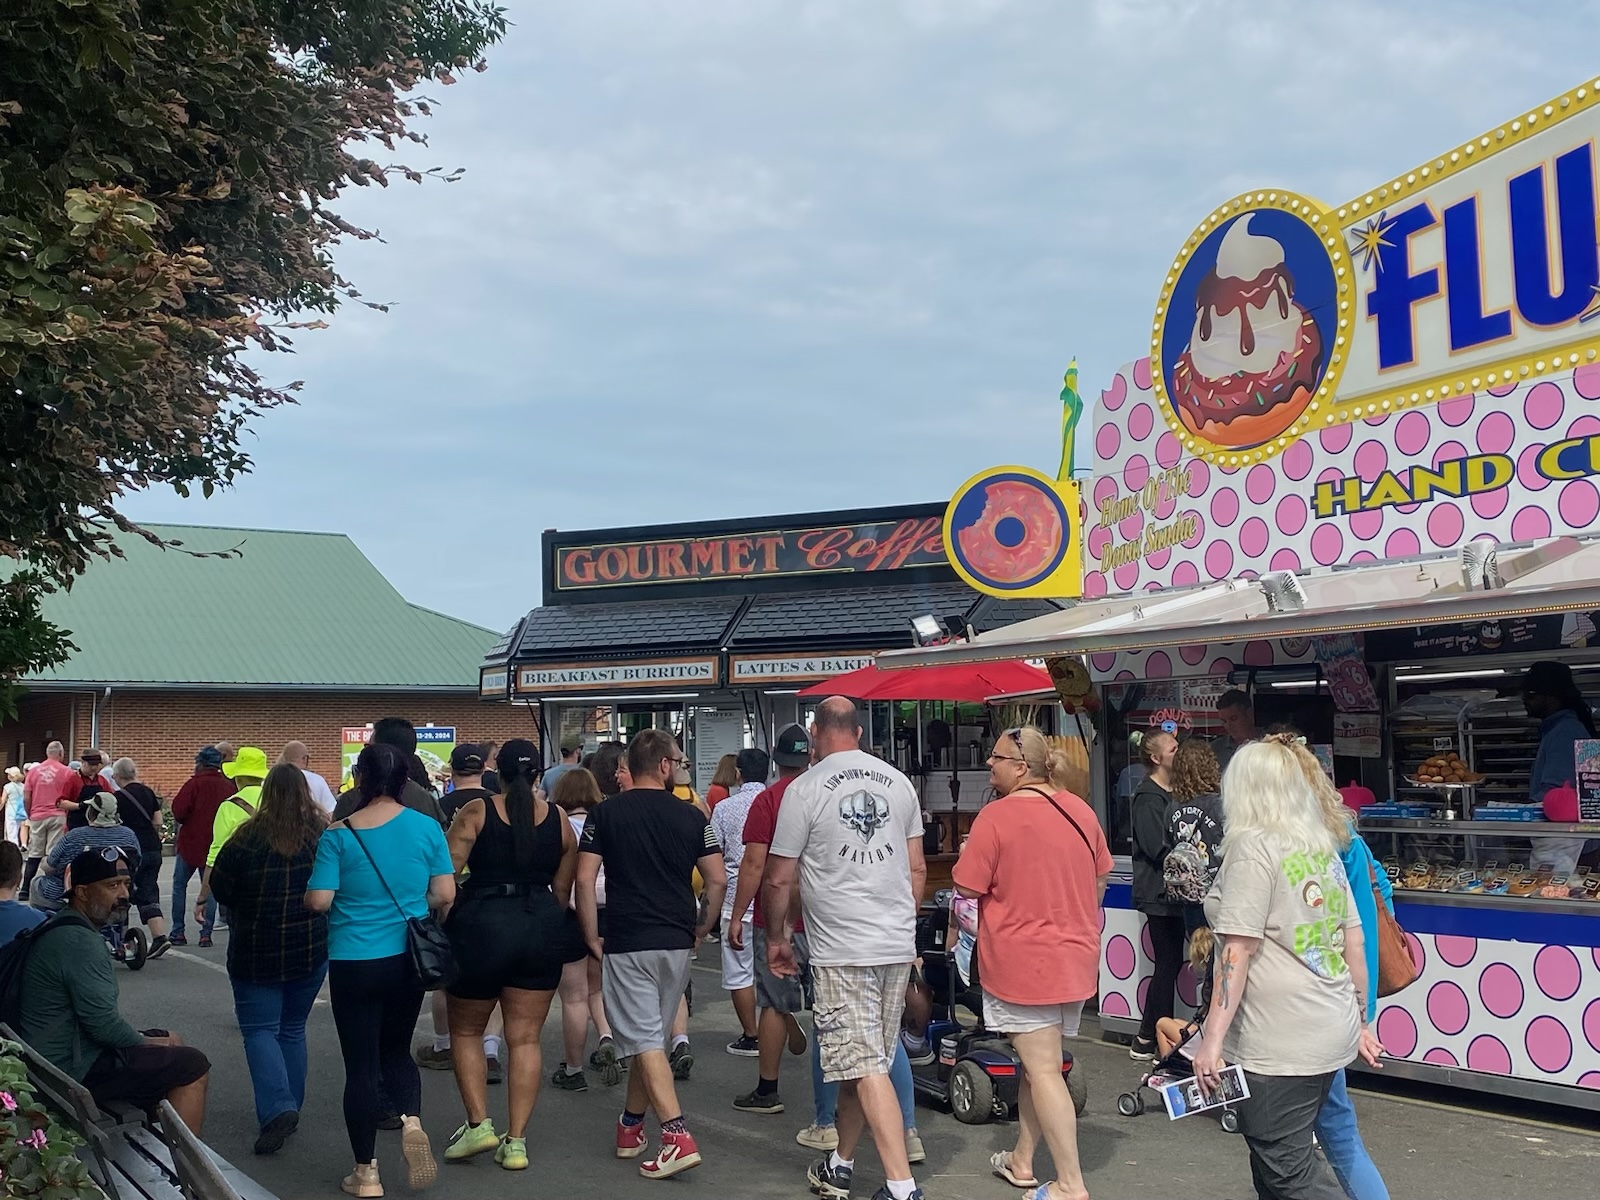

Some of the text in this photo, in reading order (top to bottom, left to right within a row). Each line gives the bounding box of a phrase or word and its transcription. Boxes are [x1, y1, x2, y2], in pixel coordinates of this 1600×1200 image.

[1367, 139, 1599, 373] FLU
[1311, 434, 1600, 519] HAND C
[1100, 464, 1192, 529] Home Of The
[1143, 511, 1197, 556] Sundae
[563, 536, 786, 584] GOURMET
[524, 664, 710, 684] BREAKFAST BURRITOS
[736, 662, 800, 675] LATTES
[803, 662, 816, 672] &
[1149, 707, 1192, 730] DONUTS
[345, 730, 361, 742] THE
[823, 768, 894, 792] LOW DOWN DIRTY
[838, 842, 895, 864] NATION
